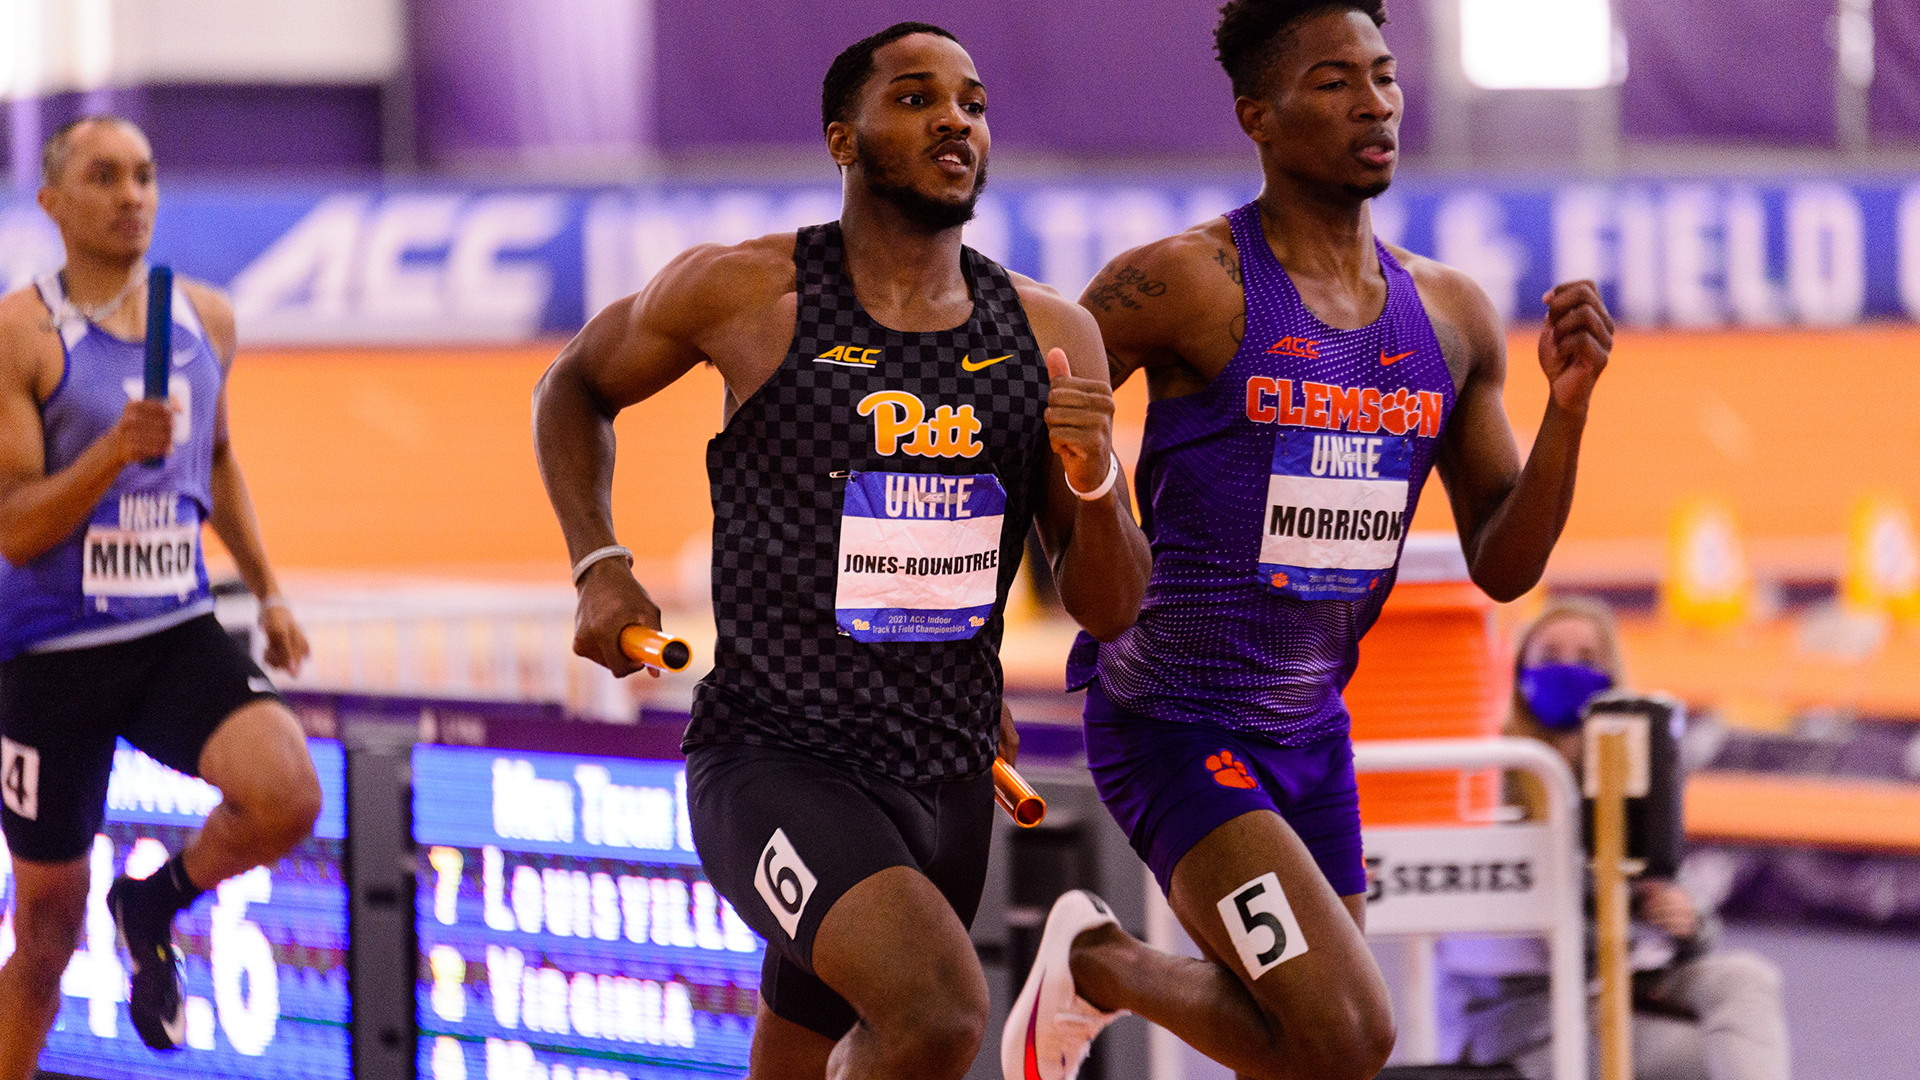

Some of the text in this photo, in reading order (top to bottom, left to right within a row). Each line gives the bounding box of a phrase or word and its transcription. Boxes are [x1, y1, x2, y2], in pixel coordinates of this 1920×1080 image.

[818, 345, 882, 364] ACC
[1270, 336, 1320, 353] ACC
[856, 390, 984, 458] Pitt
[1310, 434, 1383, 479] UNITE
[884, 474, 975, 519] UNITE
[1269, 504, 1404, 542] MORRISON
[91, 541, 191, 577] MINGO
[844, 549, 998, 576] JONES-ROUNDTREE
[872, 625, 890, 634] Track
[898, 624, 914, 633] Field
[916, 625, 966, 635] Championships
[888, 615, 952, 624] 2021 ACC Indoor
[763, 845, 804, 915] 6
[1233, 882, 1288, 967] 5
